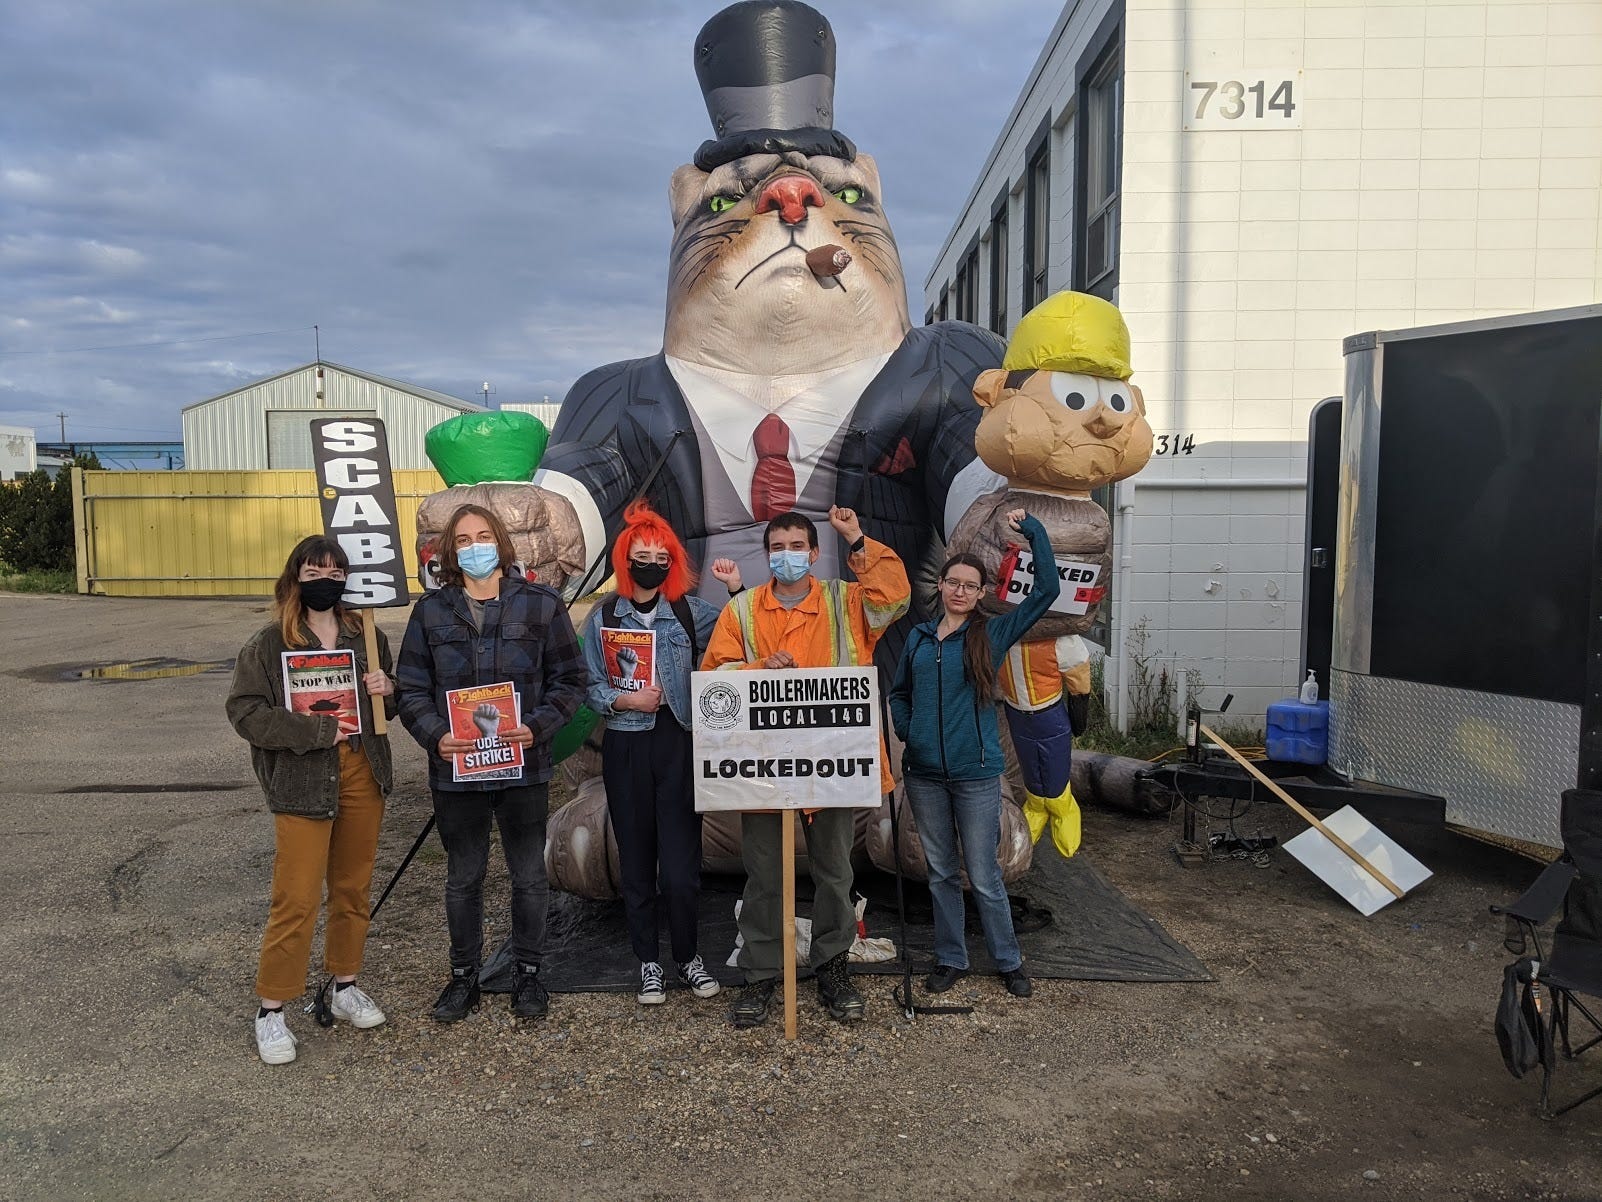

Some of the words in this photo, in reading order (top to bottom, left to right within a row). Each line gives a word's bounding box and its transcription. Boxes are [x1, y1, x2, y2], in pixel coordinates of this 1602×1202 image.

[1191, 80, 1296, 120] 7314
[1152, 433, 1196, 456] 314
[321, 421, 396, 605] SCABS
[607, 631, 651, 644] Fightback
[291, 677, 322, 689] STOP
[324, 673, 352, 686] WAR
[611, 675, 647, 689] STUDENT
[749, 676, 870, 704] BOILERMAKERS
[458, 684, 511, 704] Fightback
[757, 709, 817, 727] LOCAL
[830, 707, 863, 724] 146
[465, 747, 515, 767] STRIKE!
[703, 757, 874, 779] LOCKEDOUT
